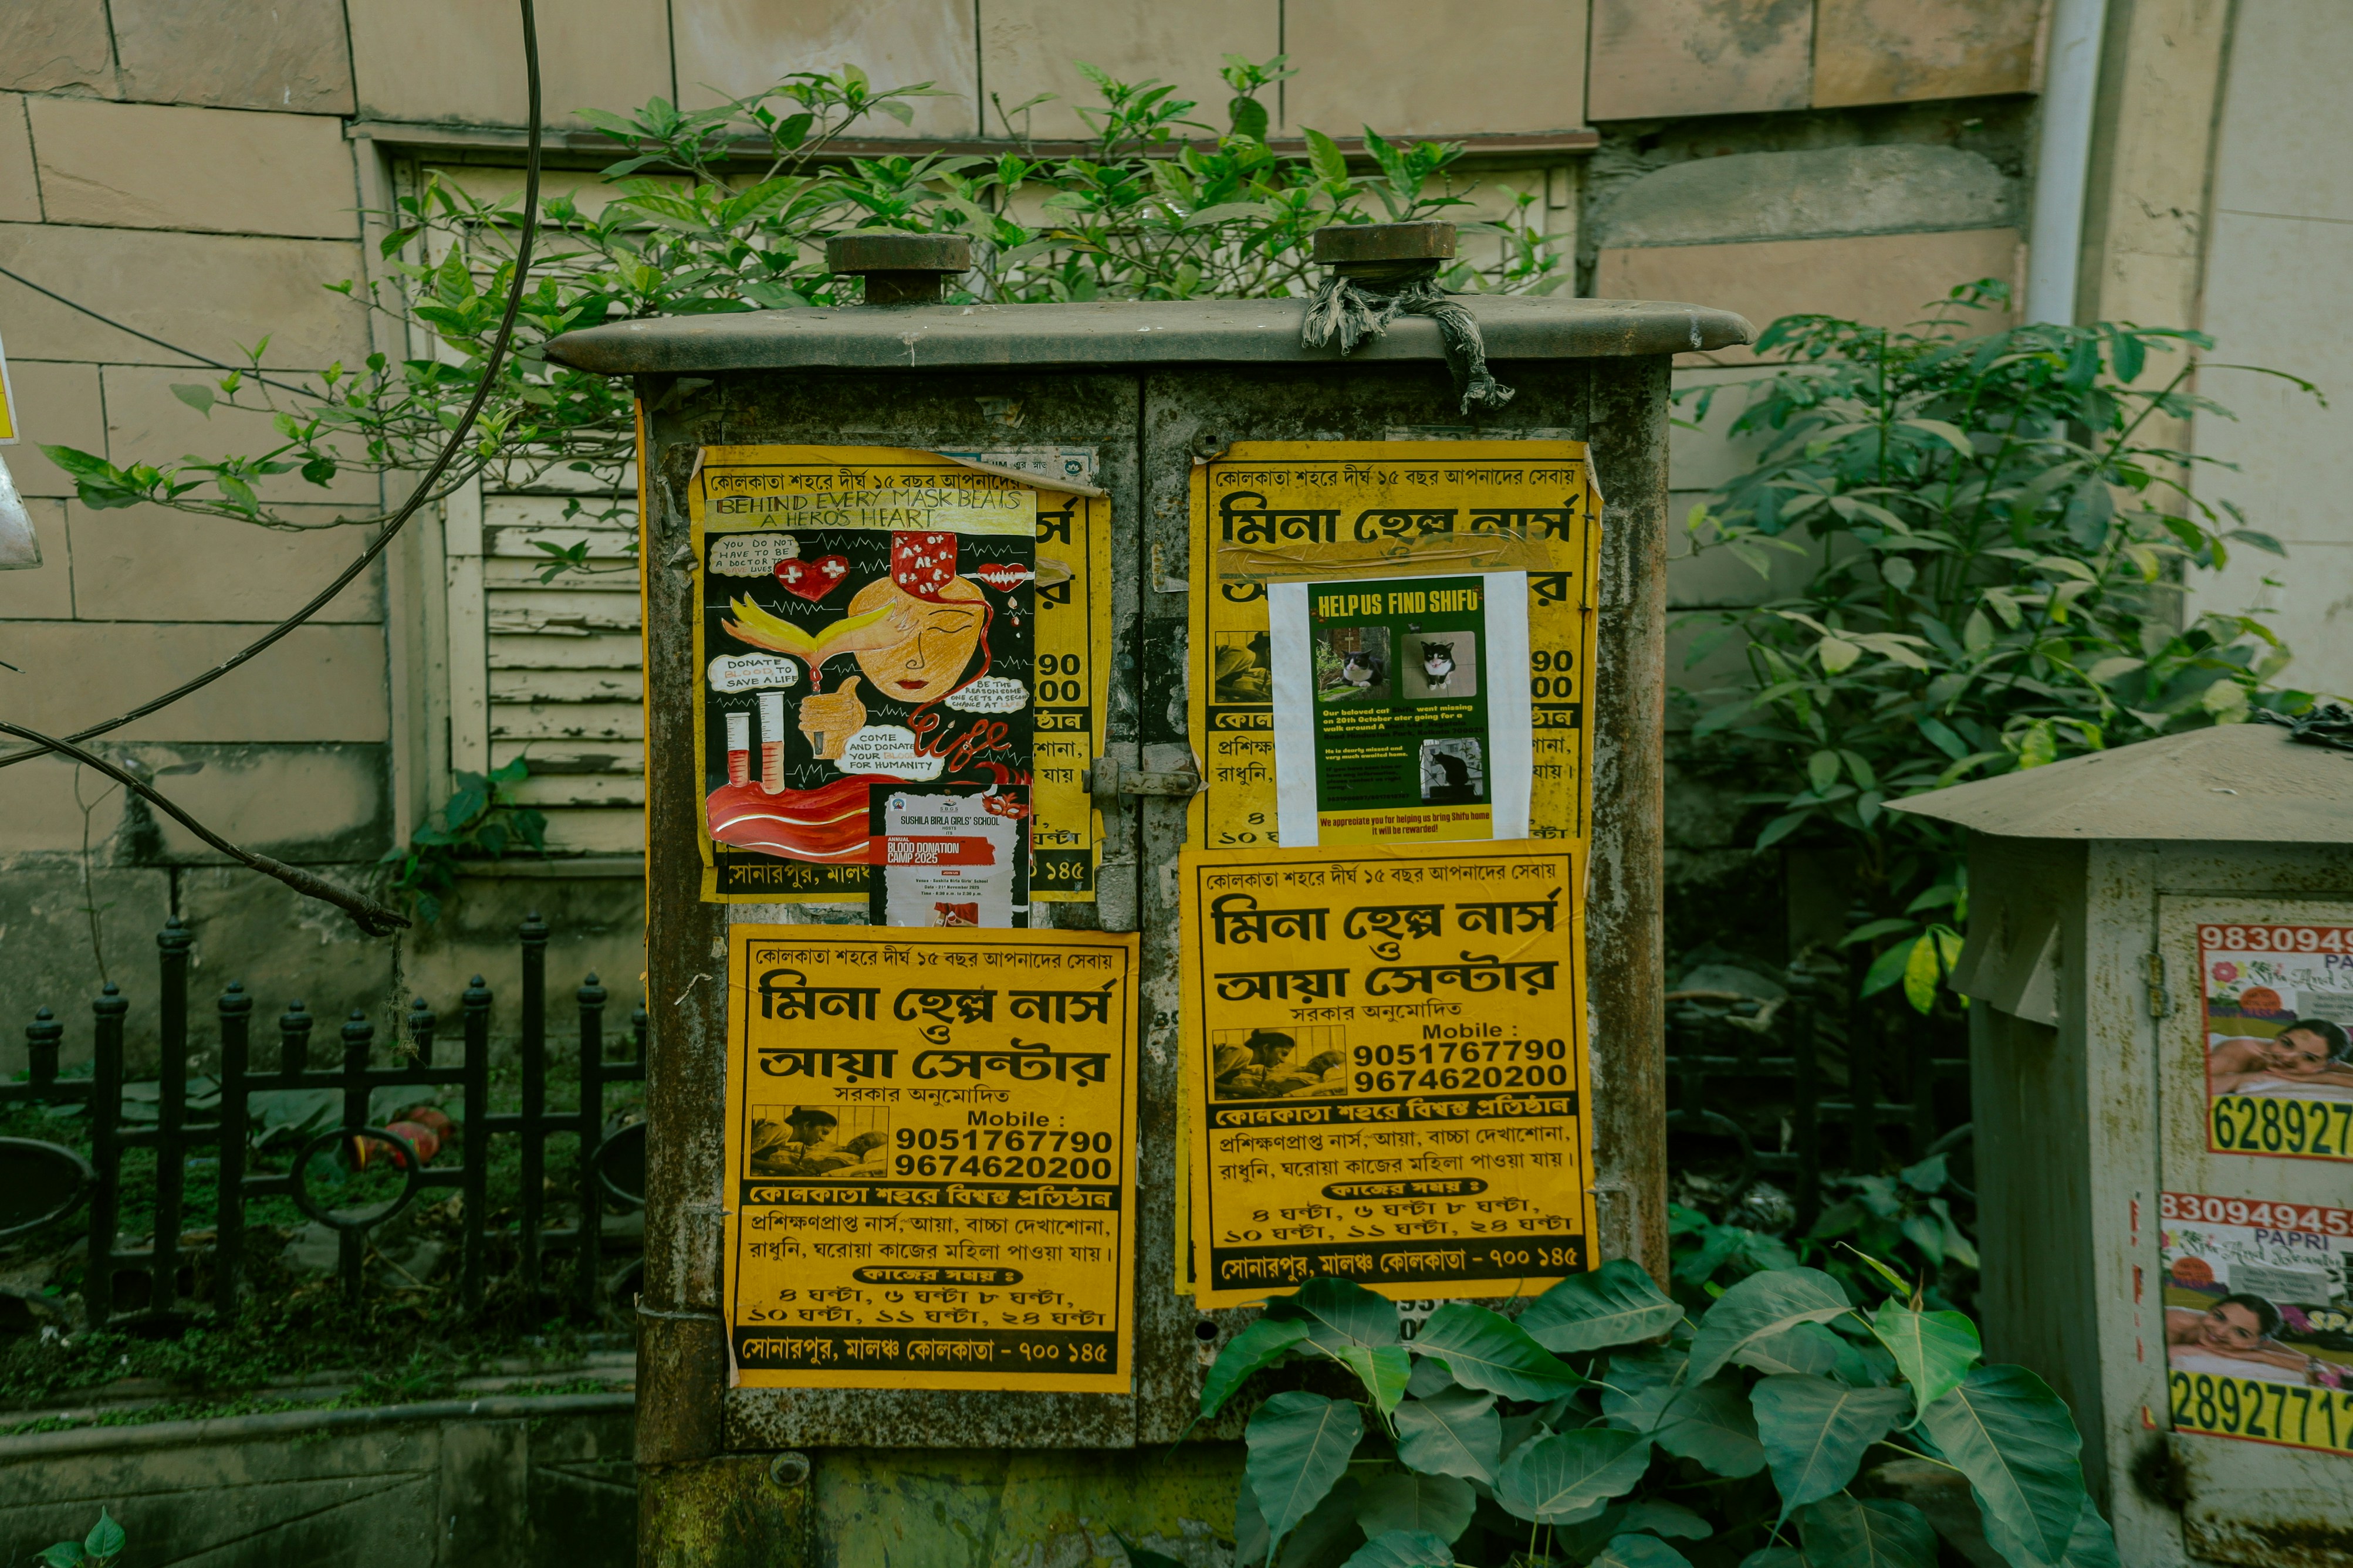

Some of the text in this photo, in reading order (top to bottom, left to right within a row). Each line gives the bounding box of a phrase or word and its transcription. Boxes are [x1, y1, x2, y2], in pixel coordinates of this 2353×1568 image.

[1216, 463, 1575, 487] কোলকাতা শহরে দীর্ঘ ১৫ বছর আপনাদের সেবায়
[716, 495, 808, 514] BEHIND
[816, 490, 882, 510] EVERY
[892, 488, 952, 509] MASK
[760, 508, 936, 529] A HERO'S HEART
[1219, 491, 1341, 544] মিনা
[723, 541, 744, 549] YOU
[752, 539, 768, 548] DO
[729, 558, 768, 567] DOCTOR
[1318, 589, 1478, 618] HELP US FIND SHIFU
[725, 668, 772, 679] BLOOD
[728, 659, 781, 669] DONATE
[726, 678, 759, 687] SAVE
[775, 675, 799, 683] LIFE
[1341, 708, 1374, 716] beloved
[1414, 713, 1439, 722] going
[849, 742, 914, 751] AND DONATE
[860, 733, 897, 742] COME
[850, 761, 932, 771] FOR HUMANITY
[901, 815, 1000, 826] SUSHILA BIRLA GIRLS' SCHOOL
[1320, 811, 1490, 828] We appreciate you for helping us bring Shifu home
[1372, 824, 1438, 835] it will be rewarded!
[887, 842, 959, 854] BLOOD DONATION
[887, 853, 938, 863] CAMP 2025
[1211, 886, 1562, 945] মিনা হেল্প নার্স
[755, 944, 1114, 970] কোলকাতা শহরে দীর্ঘ ১৫ বছর আপনাদের সেবায়
[1368, 940, 1402, 961] ও
[1214, 950, 1559, 1004] আয়া সেন্টার
[758, 968, 1118, 1025] মিনা হেল্প নার্স
[1289, 998, 1463, 1024] সরকার অনুমোদিত
[918, 1025, 951, 1045] ও
[1422, 1022, 1503, 1041] Mobile
[758, 1036, 1111, 1088] আয়া সেন্টার
[1353, 1038, 1566, 1068] 9051767790
[1353, 1065, 1567, 1094] 9674620200
[832, 1083, 1012, 1106] সরকার অনুমোদিত
[968, 1109, 1050, 1128] Mobile
[1215, 1095, 1570, 1127] কোলকাতা শহরে বিশ্বস্ত প্রতিষ্ঠান
[895, 1127, 1113, 1154] 9051767790
[894, 1153, 1113, 1181] 9674620200
[749, 1183, 1113, 1209] কোলকাতা শহরে বিশ্বস্ত প্রতিষ্ঠান
[2161, 1194, 2353, 1237] 83094945
[2255, 1228, 2330, 1251] PAPRI
[862, 1268, 998, 1283] কাজের সময়
[741, 1336, 1109, 1366] সোনারপুর, মালঞ্চ কোলকাতা ৭০০ ১৪৫
